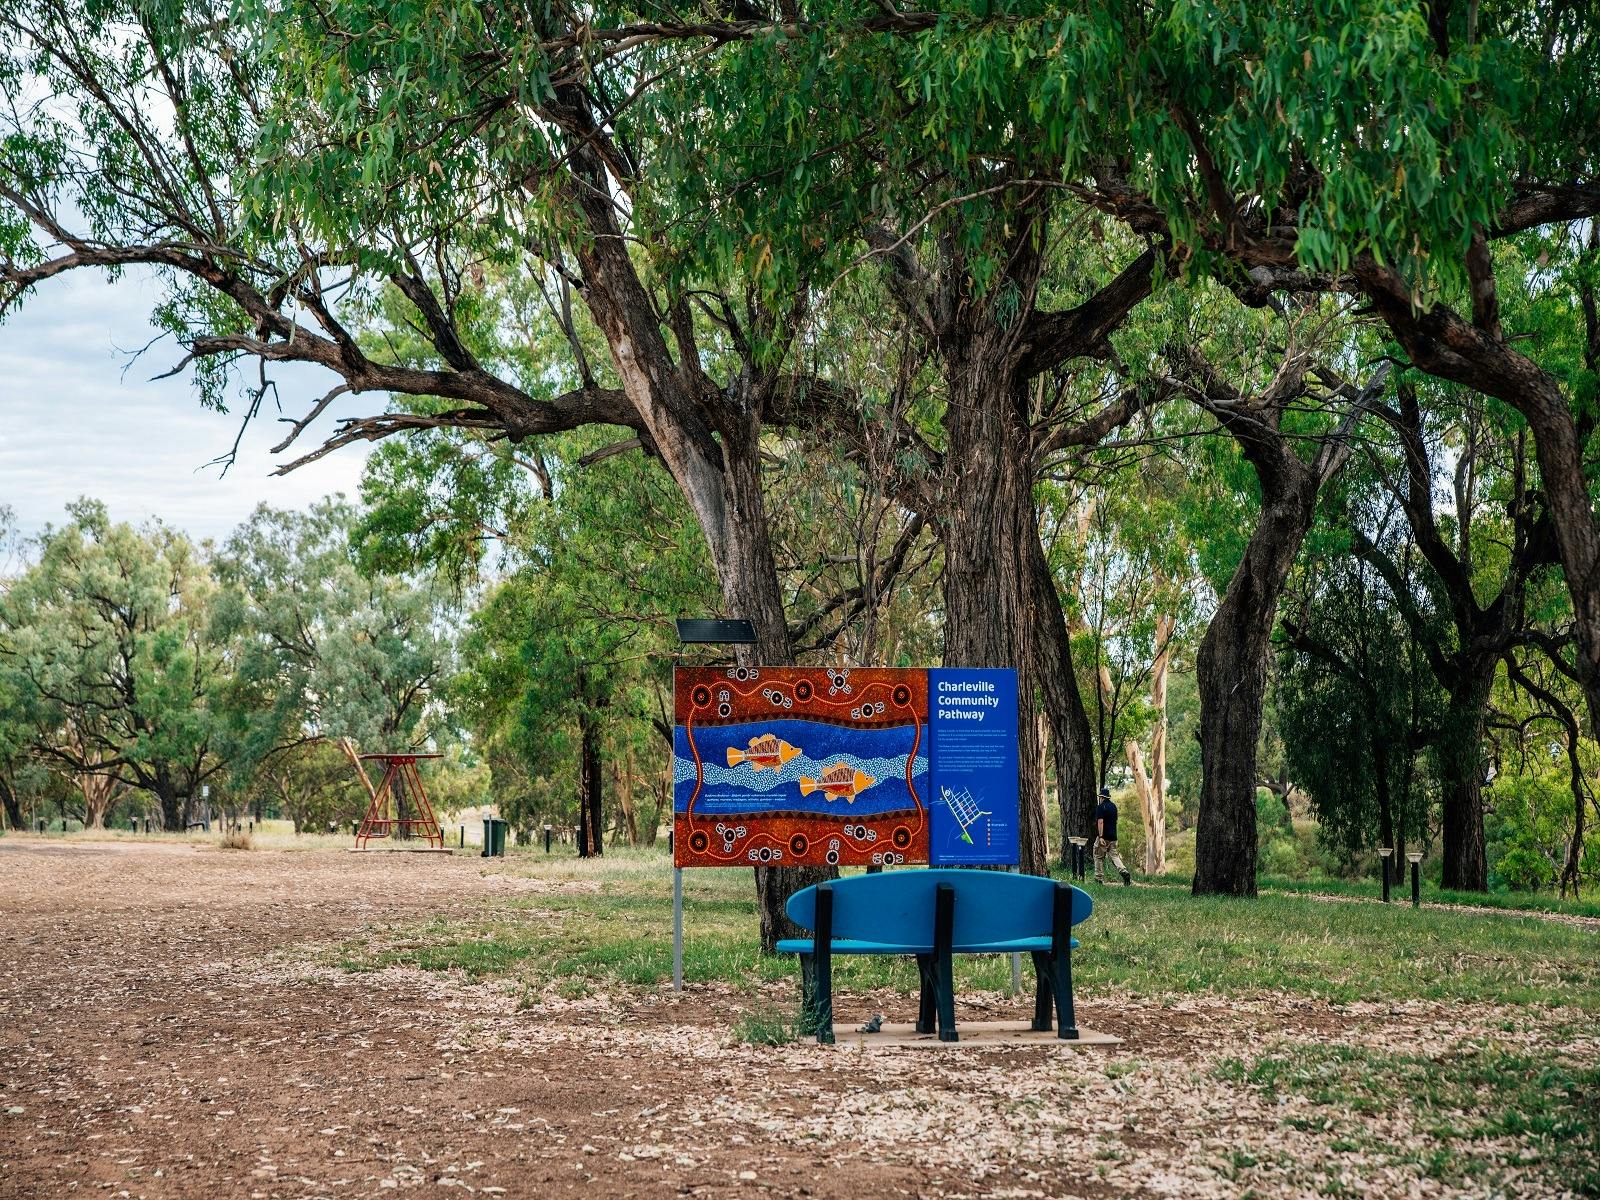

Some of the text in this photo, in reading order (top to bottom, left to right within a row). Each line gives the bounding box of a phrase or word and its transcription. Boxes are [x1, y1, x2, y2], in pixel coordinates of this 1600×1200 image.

[938, 681, 995, 692] Charleville
[938, 695, 999, 708] Community
[938, 709, 985, 722] Pathway
